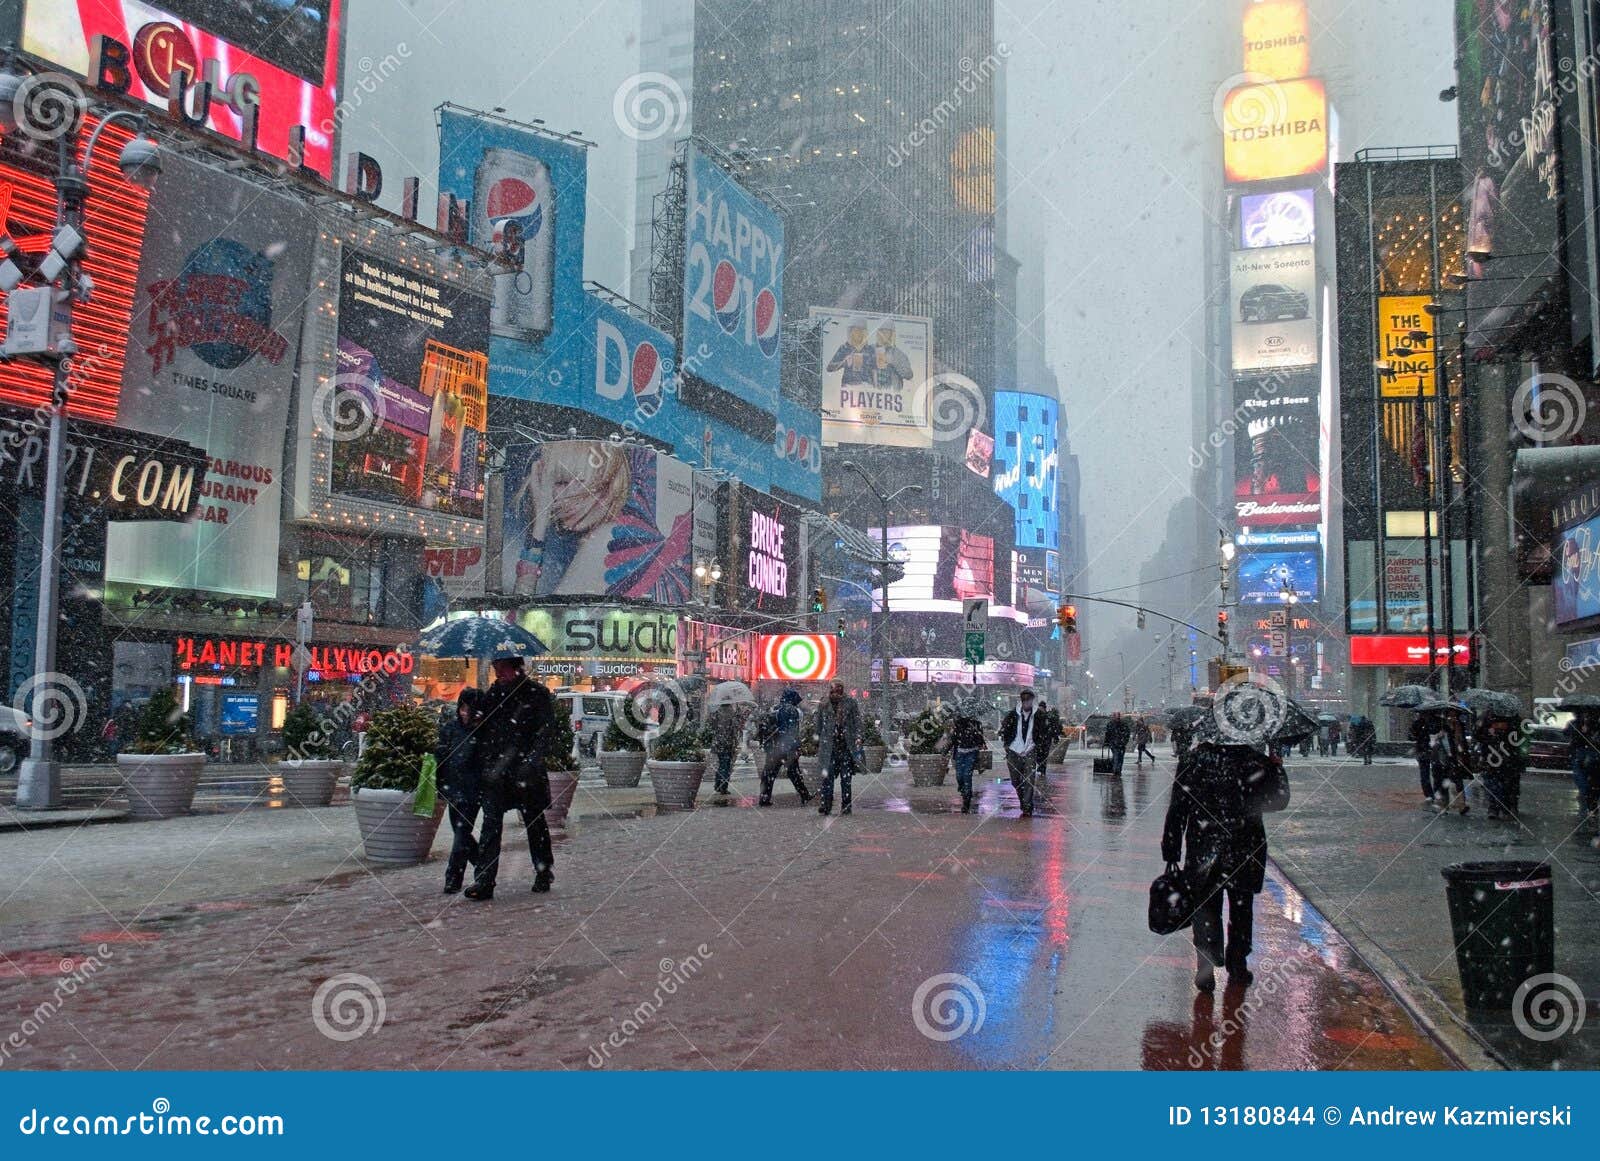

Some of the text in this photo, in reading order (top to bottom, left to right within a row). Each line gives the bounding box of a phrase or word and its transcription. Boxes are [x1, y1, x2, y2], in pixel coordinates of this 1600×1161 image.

[1247, 34, 1306, 51] TOSHIBA
[1230, 118, 1321, 142] TOSHIBA
[687, 179, 783, 287] HAPPY
[1236, 258, 1310, 273] All-New Sorento
[420, 298, 432, 312] Las
[1391, 314, 1421, 328] THE
[1385, 333, 1427, 356] LION
[1386, 360, 1429, 384] KING
[172, 372, 257, 403] TIMES SQUARE
[840, 389, 903, 413] PLAYERS
[1244, 399, 1268, 408] King
[1235, 501, 1320, 517] Budweiser
[752, 510, 785, 561] BRUCE
[748, 550, 788, 599] CONNER
[1387, 575, 1420, 583] DANCE
[966, 622, 984, 630] ONLY
[177, 637, 414, 674] PLANET HLLYWOOD
[537, 663, 576, 675] swatch
[595, 663, 638, 675] swatch
